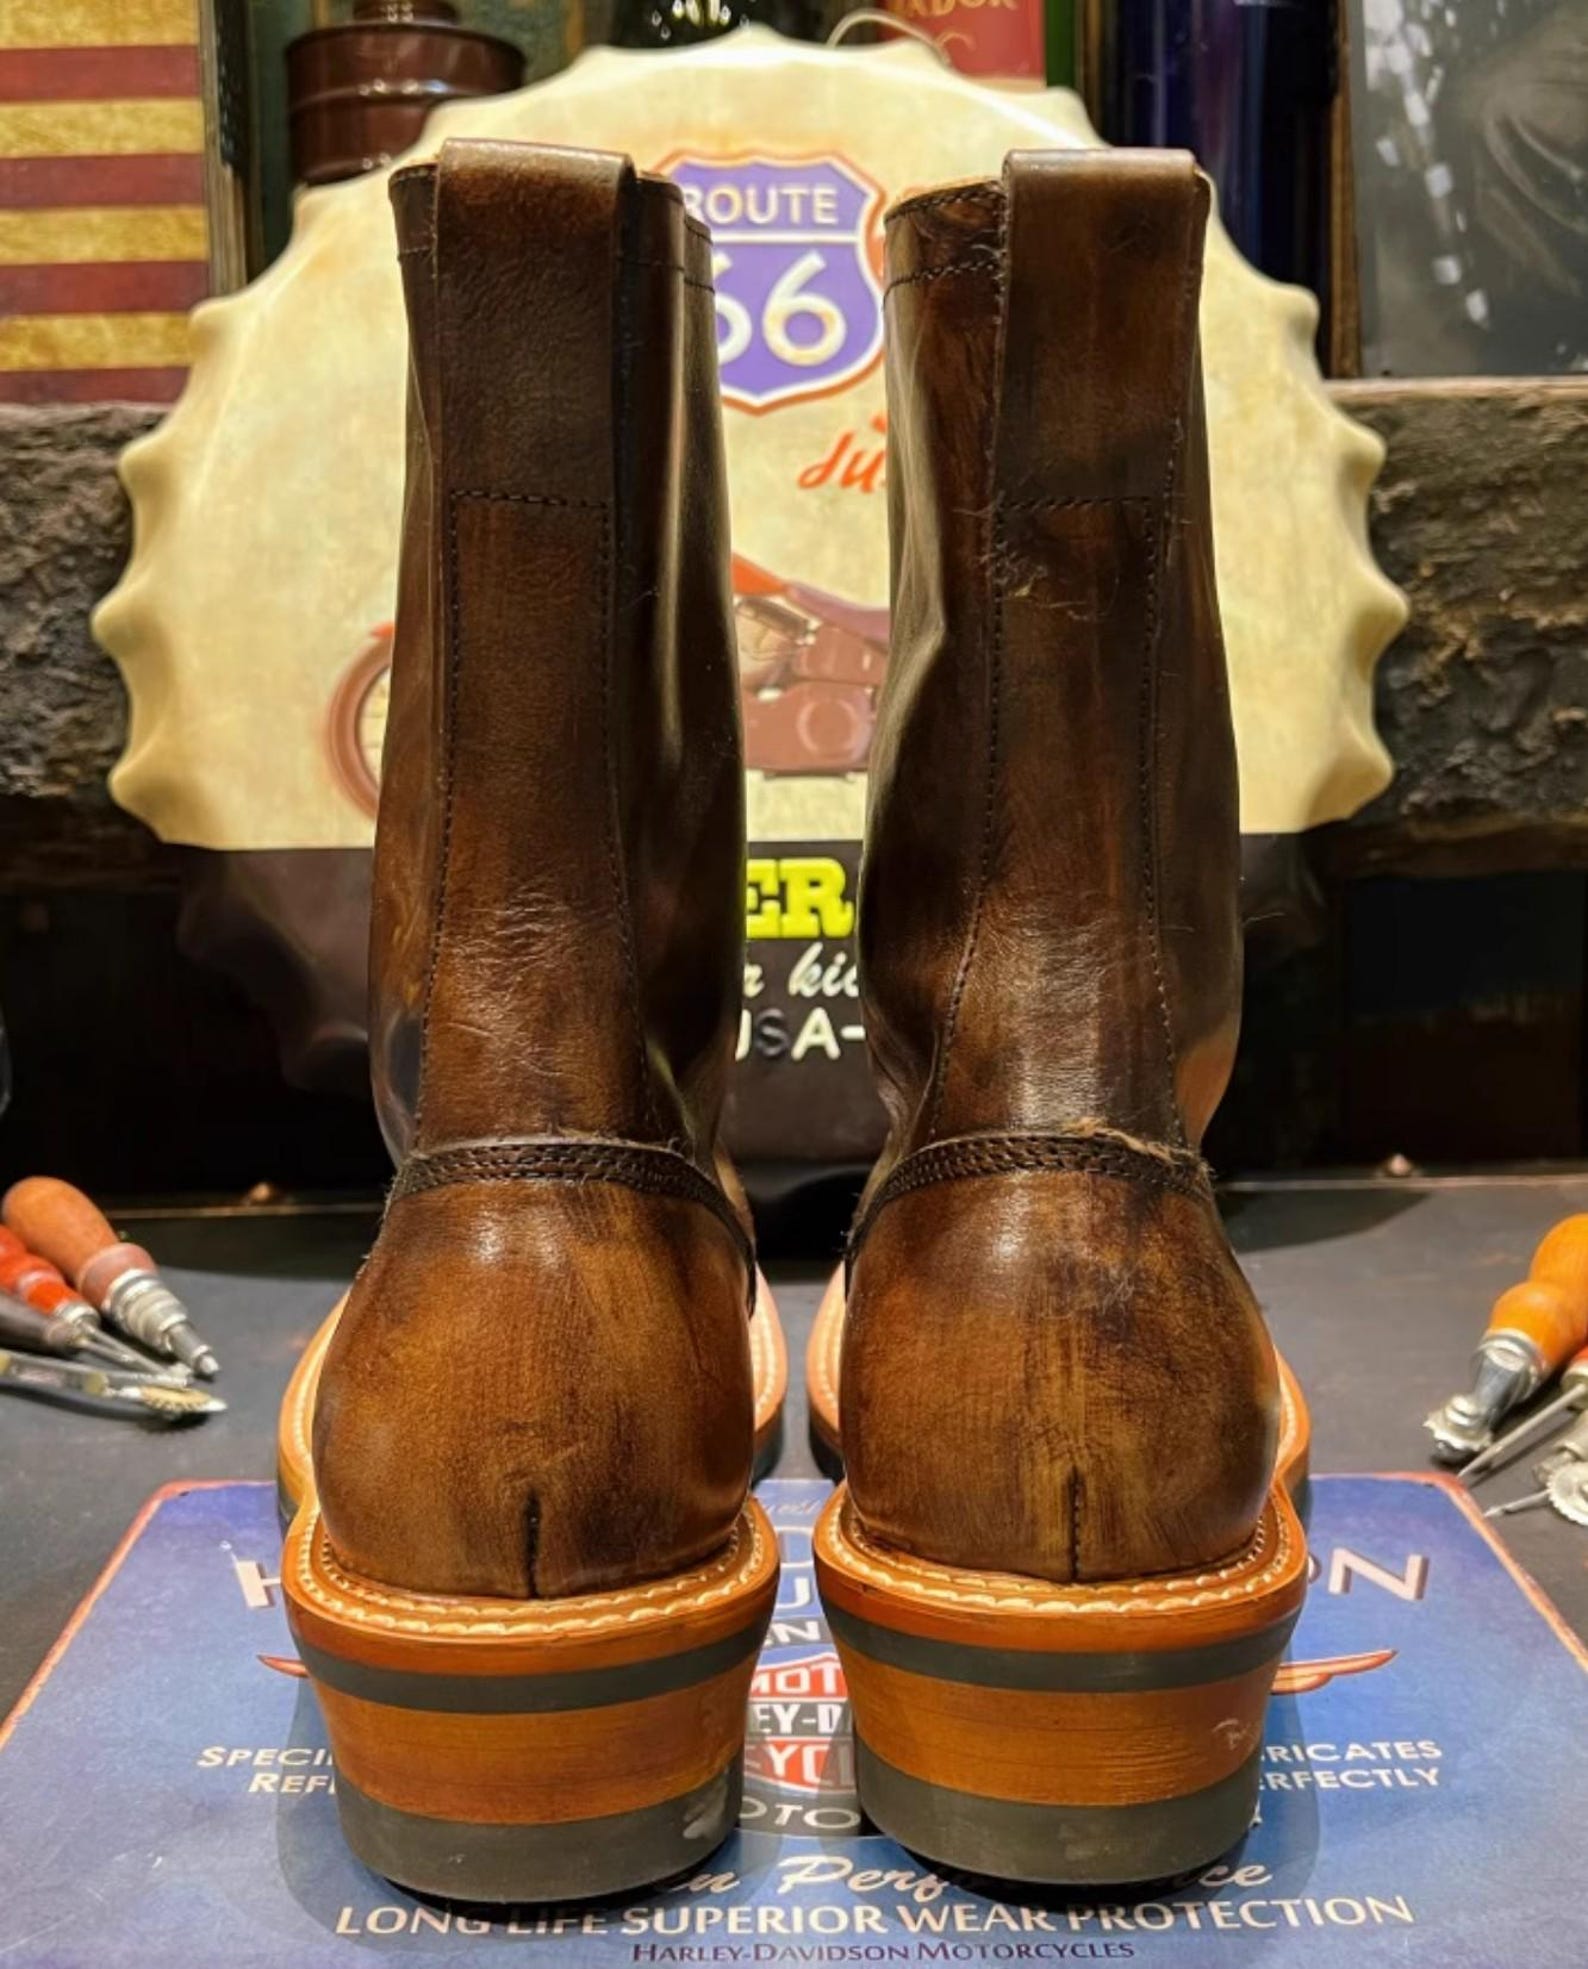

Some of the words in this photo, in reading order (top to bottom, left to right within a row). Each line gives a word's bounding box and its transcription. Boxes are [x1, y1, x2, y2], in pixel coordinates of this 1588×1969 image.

[683, 184, 839, 225] ROUTE
[735, 1007, 866, 1061] SA-
[197, 1746, 333, 1767] SPECI
[1260, 1739, 1443, 1763] RICATES
[1259, 1766, 1440, 1791] RFECTLY
[335, 1906, 491, 1935] LONG
[620, 1904, 889, 1935] SUPERIOR
[896, 1903, 1057, 1934] WEAR
[1067, 1895, 1415, 1931] PROTECTION
[632, 1942, 909, 1963] HARLEY-DAVIDSON
[917, 1941, 1135, 1961] MOTORCYCLES
